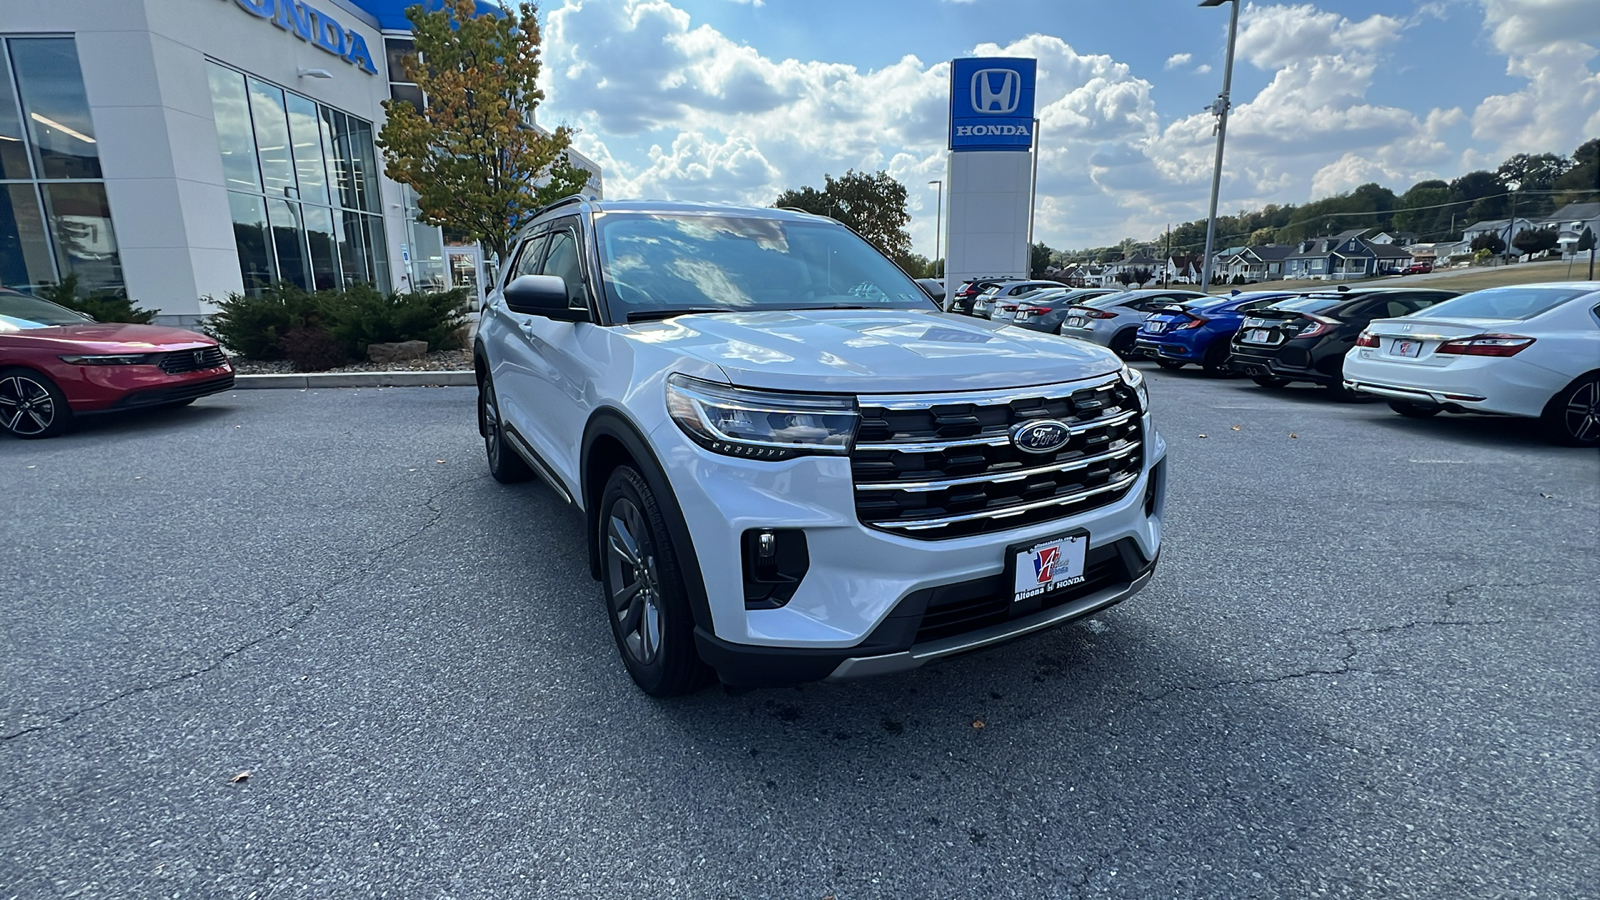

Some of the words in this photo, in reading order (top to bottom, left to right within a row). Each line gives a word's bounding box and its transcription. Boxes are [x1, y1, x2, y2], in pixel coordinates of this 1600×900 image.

[232, 0, 378, 75] NDA
[956, 125, 1030, 136] HONDA
[1030, 426, 1061, 447] Ford
[1014, 588, 1045, 603] Altoona
[1056, 576, 1086, 589] HONDA
